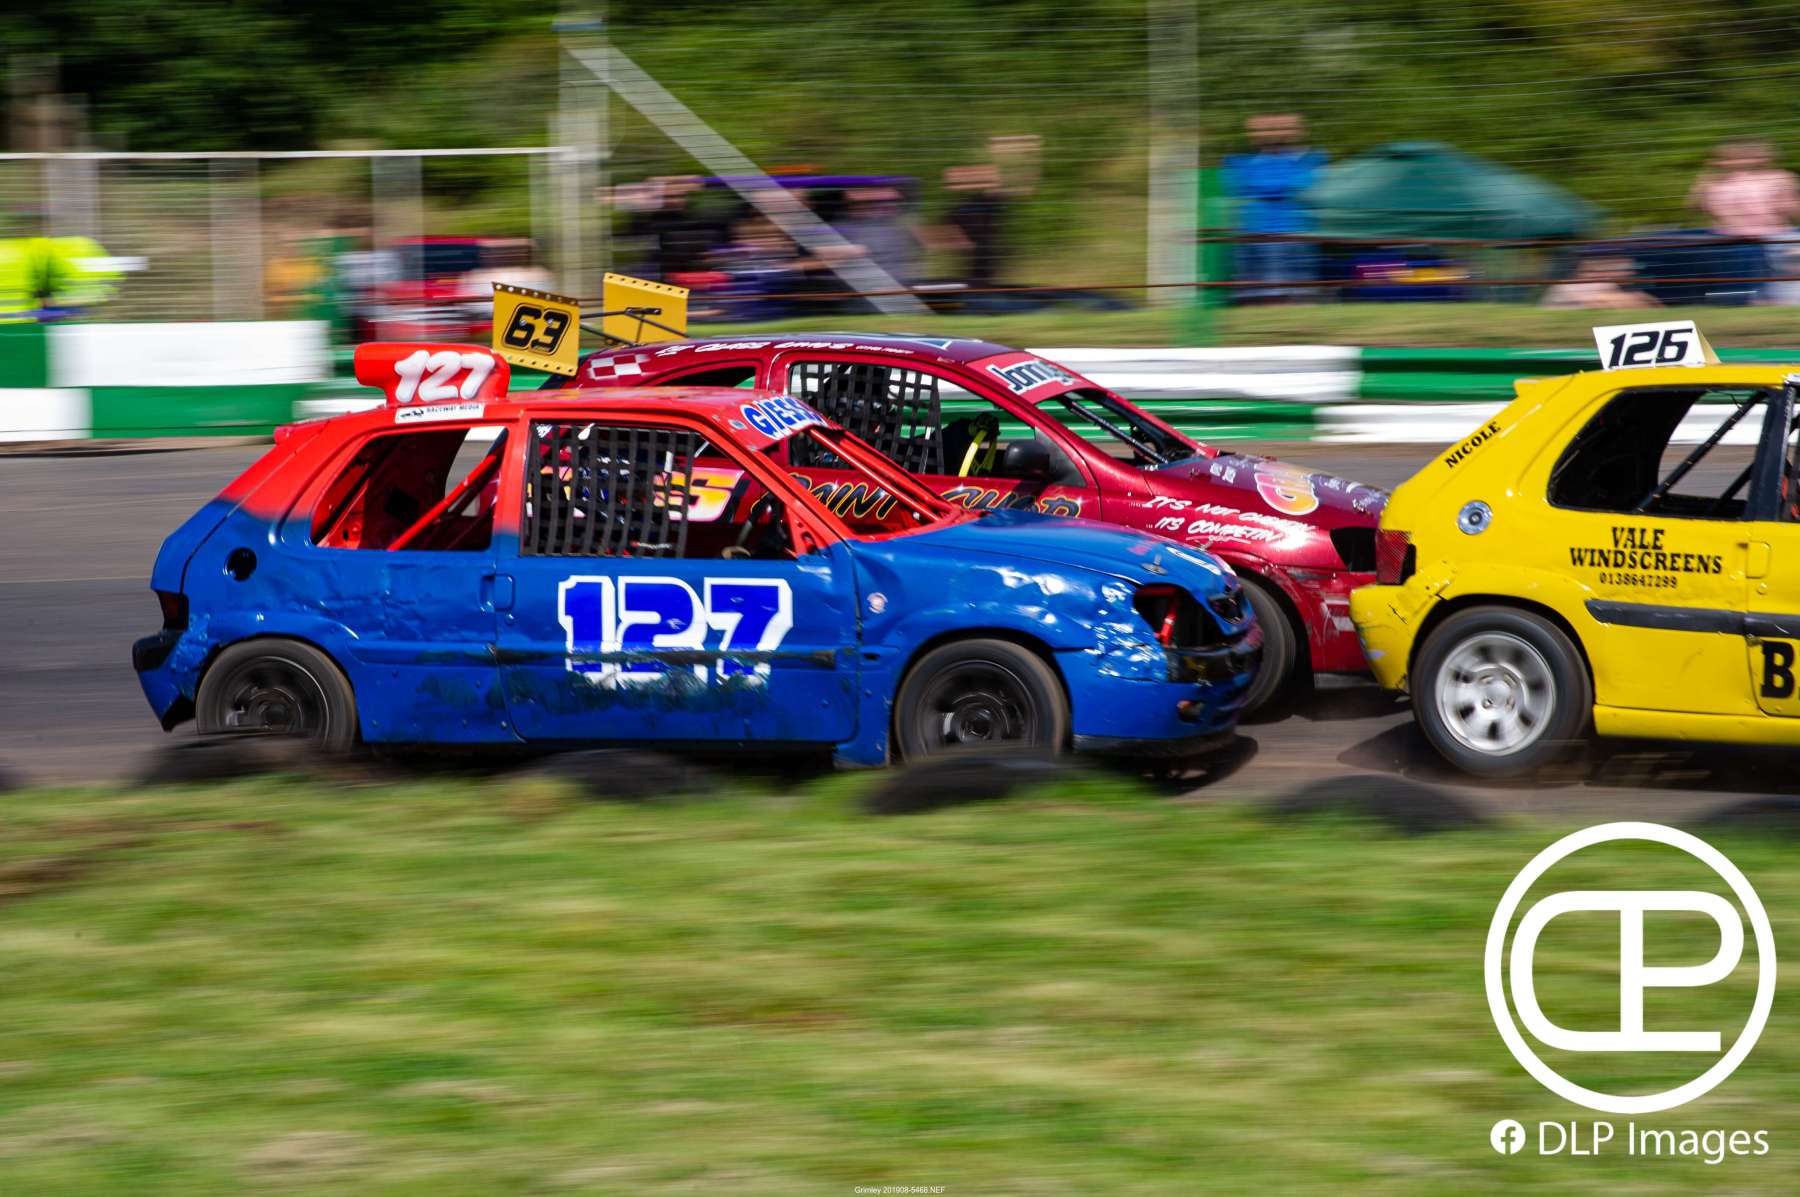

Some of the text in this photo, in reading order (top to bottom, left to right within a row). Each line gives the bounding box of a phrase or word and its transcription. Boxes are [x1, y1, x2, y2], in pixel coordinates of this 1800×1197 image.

[503, 304, 570, 354] 63
[1608, 327, 1693, 368] 126
[394, 350, 496, 403] 127
[1445, 421, 1501, 469] NICOLE
[1195, 503, 1240, 516] NOT
[1569, 547, 1723, 574] WINDSCREENS
[1611, 526, 1665, 550] VALE
[558, 575, 793, 690] 127
[1761, 640, 1800, 698] B
